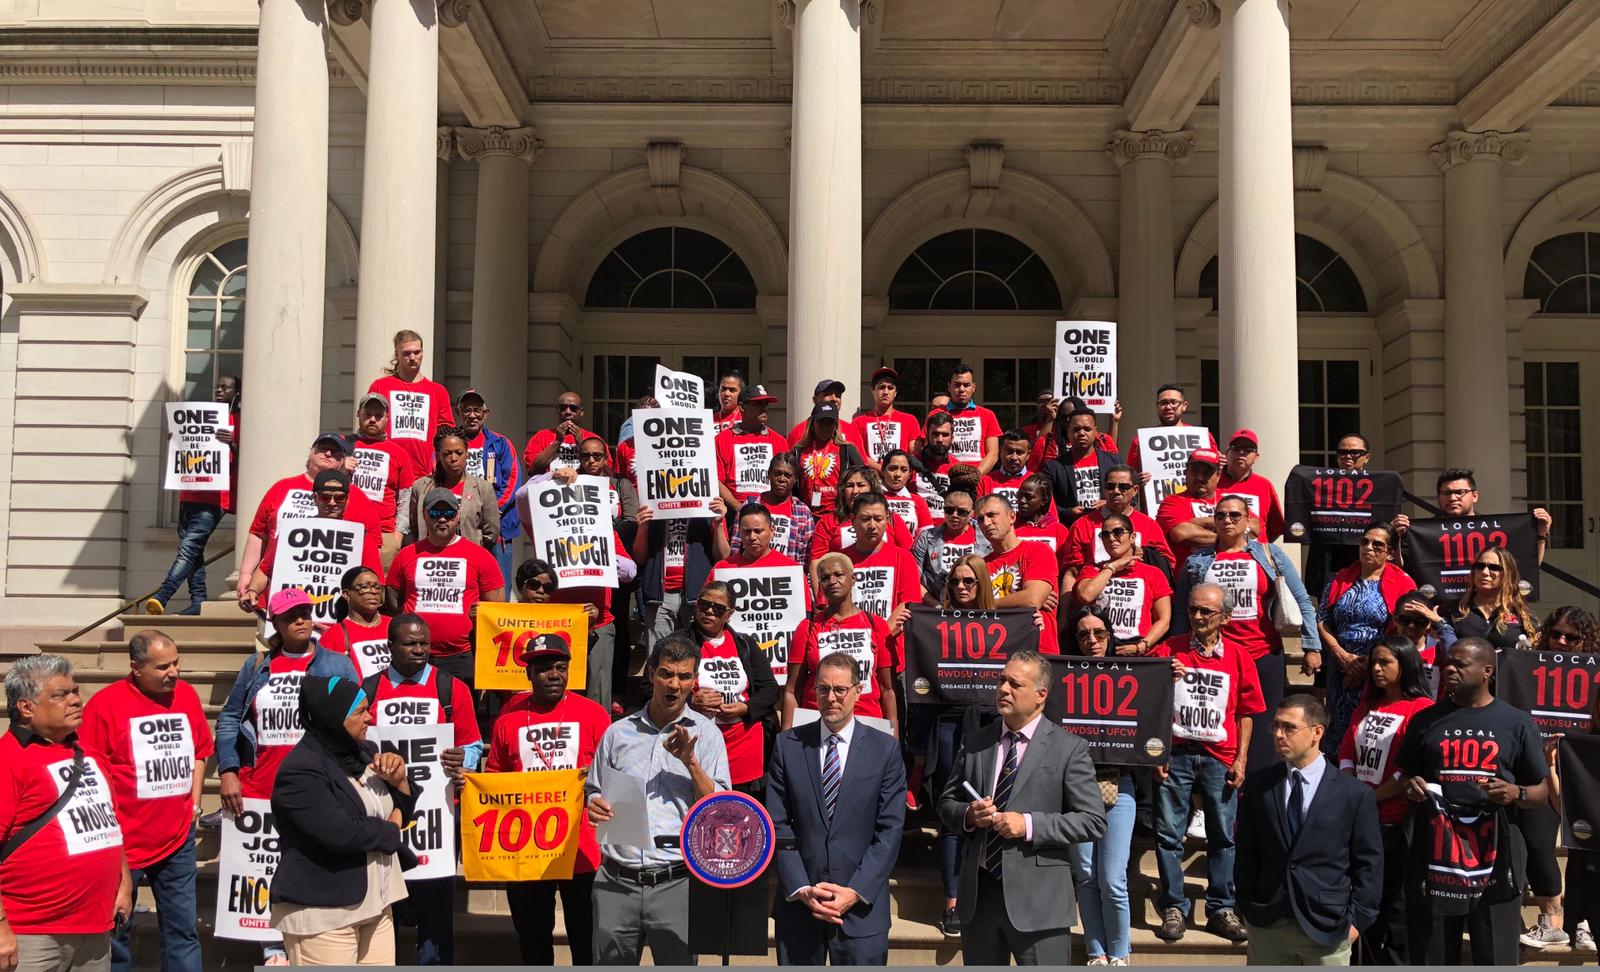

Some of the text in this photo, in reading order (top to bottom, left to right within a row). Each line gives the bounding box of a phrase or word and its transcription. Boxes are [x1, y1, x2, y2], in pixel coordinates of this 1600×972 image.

[1064, 329, 1110, 344] ONE
[1069, 346, 1108, 355] JOB
[660, 375, 699, 396] ONE
[1062, 372, 1112, 396] ENOUGH
[395, 393, 425, 403] ONE
[665, 391, 698, 404] JOB
[174, 410, 219, 425] ONE
[395, 416, 425, 431] ENOUGH
[179, 425, 215, 434] JOB
[643, 418, 704, 437] ONE
[652, 437, 700, 449] JOB
[1148, 435, 1201, 451] ONE
[353, 451, 384, 462] ONE
[658, 450, 696, 459] SHOULD
[739, 446, 768, 455] ONE
[174, 451, 221, 474] ENOUGH
[467, 452, 483, 462] NE
[672, 459, 684, 467] BE
[356, 461, 381, 469] JOB
[352, 476, 382, 491] NOUGH
[646, 468, 711, 500] ENOUGH
[292, 491, 314, 500] ON
[540, 485, 600, 507] ONE
[1153, 479, 1187, 504] ENO
[1311, 477, 1374, 509] 1102
[549, 504, 599, 519] JOB
[556, 518, 595, 527] SHOULD
[771, 519, 789, 527] NE
[1442, 521, 1500, 530] LOCAL
[571, 526, 585, 534] BE
[288, 528, 354, 551] ONE
[293, 550, 348, 564] JOB
[545, 536, 610, 568] ENOUGH
[298, 563, 342, 575] SHOULD
[423, 561, 460, 570] ONE
[1211, 562, 1250, 570] ONE
[312, 575, 327, 583] BE
[853, 570, 888, 582] ONE
[728, 577, 792, 597] ONE
[858, 580, 885, 591] JOB
[421, 588, 460, 603] ENOUGH
[1104, 588, 1135, 596] JOB
[1231, 588, 1252, 608] UGH
[736, 597, 788, 612] JOB
[741, 612, 783, 622] SHOULD
[941, 610, 1000, 619] LOCAL
[497, 618, 572, 628] UNITEHERE!
[756, 622, 769, 631] BE
[827, 632, 865, 643] ONE
[936, 621, 1007, 659] 1102
[362, 644, 391, 656] ON
[831, 641, 864, 649] JOB
[371, 655, 391, 664] JO
[704, 660, 740, 674] ONE
[1067, 662, 1132, 670] LOCAL
[710, 671, 740, 679] JOB
[938, 670, 973, 678] RWDSU
[1183, 672, 1224, 688] ONE
[1187, 686, 1219, 696] JOB
[1532, 666, 1600, 709] 110
[1062, 672, 1139, 716] 1102
[384, 702, 431, 716] ONE
[262, 709, 301, 731] ENOUG
[389, 716, 427, 724] JOB
[1180, 706, 1221, 730] ENOUGH
[139, 718, 184, 735] ONE
[1107, 728, 1137, 736] UFCW
[147, 733, 182, 744] JOB
[526, 727, 572, 742] ONE
[1445, 729, 1495, 737] LOCAL
[531, 741, 567, 751] JOB
[1440, 738, 1499, 770] 1102
[145, 755, 191, 783] ENOUGH
[479, 791, 567, 805] UNITEHERE!
[473, 807, 569, 852] 100
[243, 836, 281, 852] JO
[228, 874, 271, 915] ENO
[1430, 890, 1467, 899] ORGANIZE
